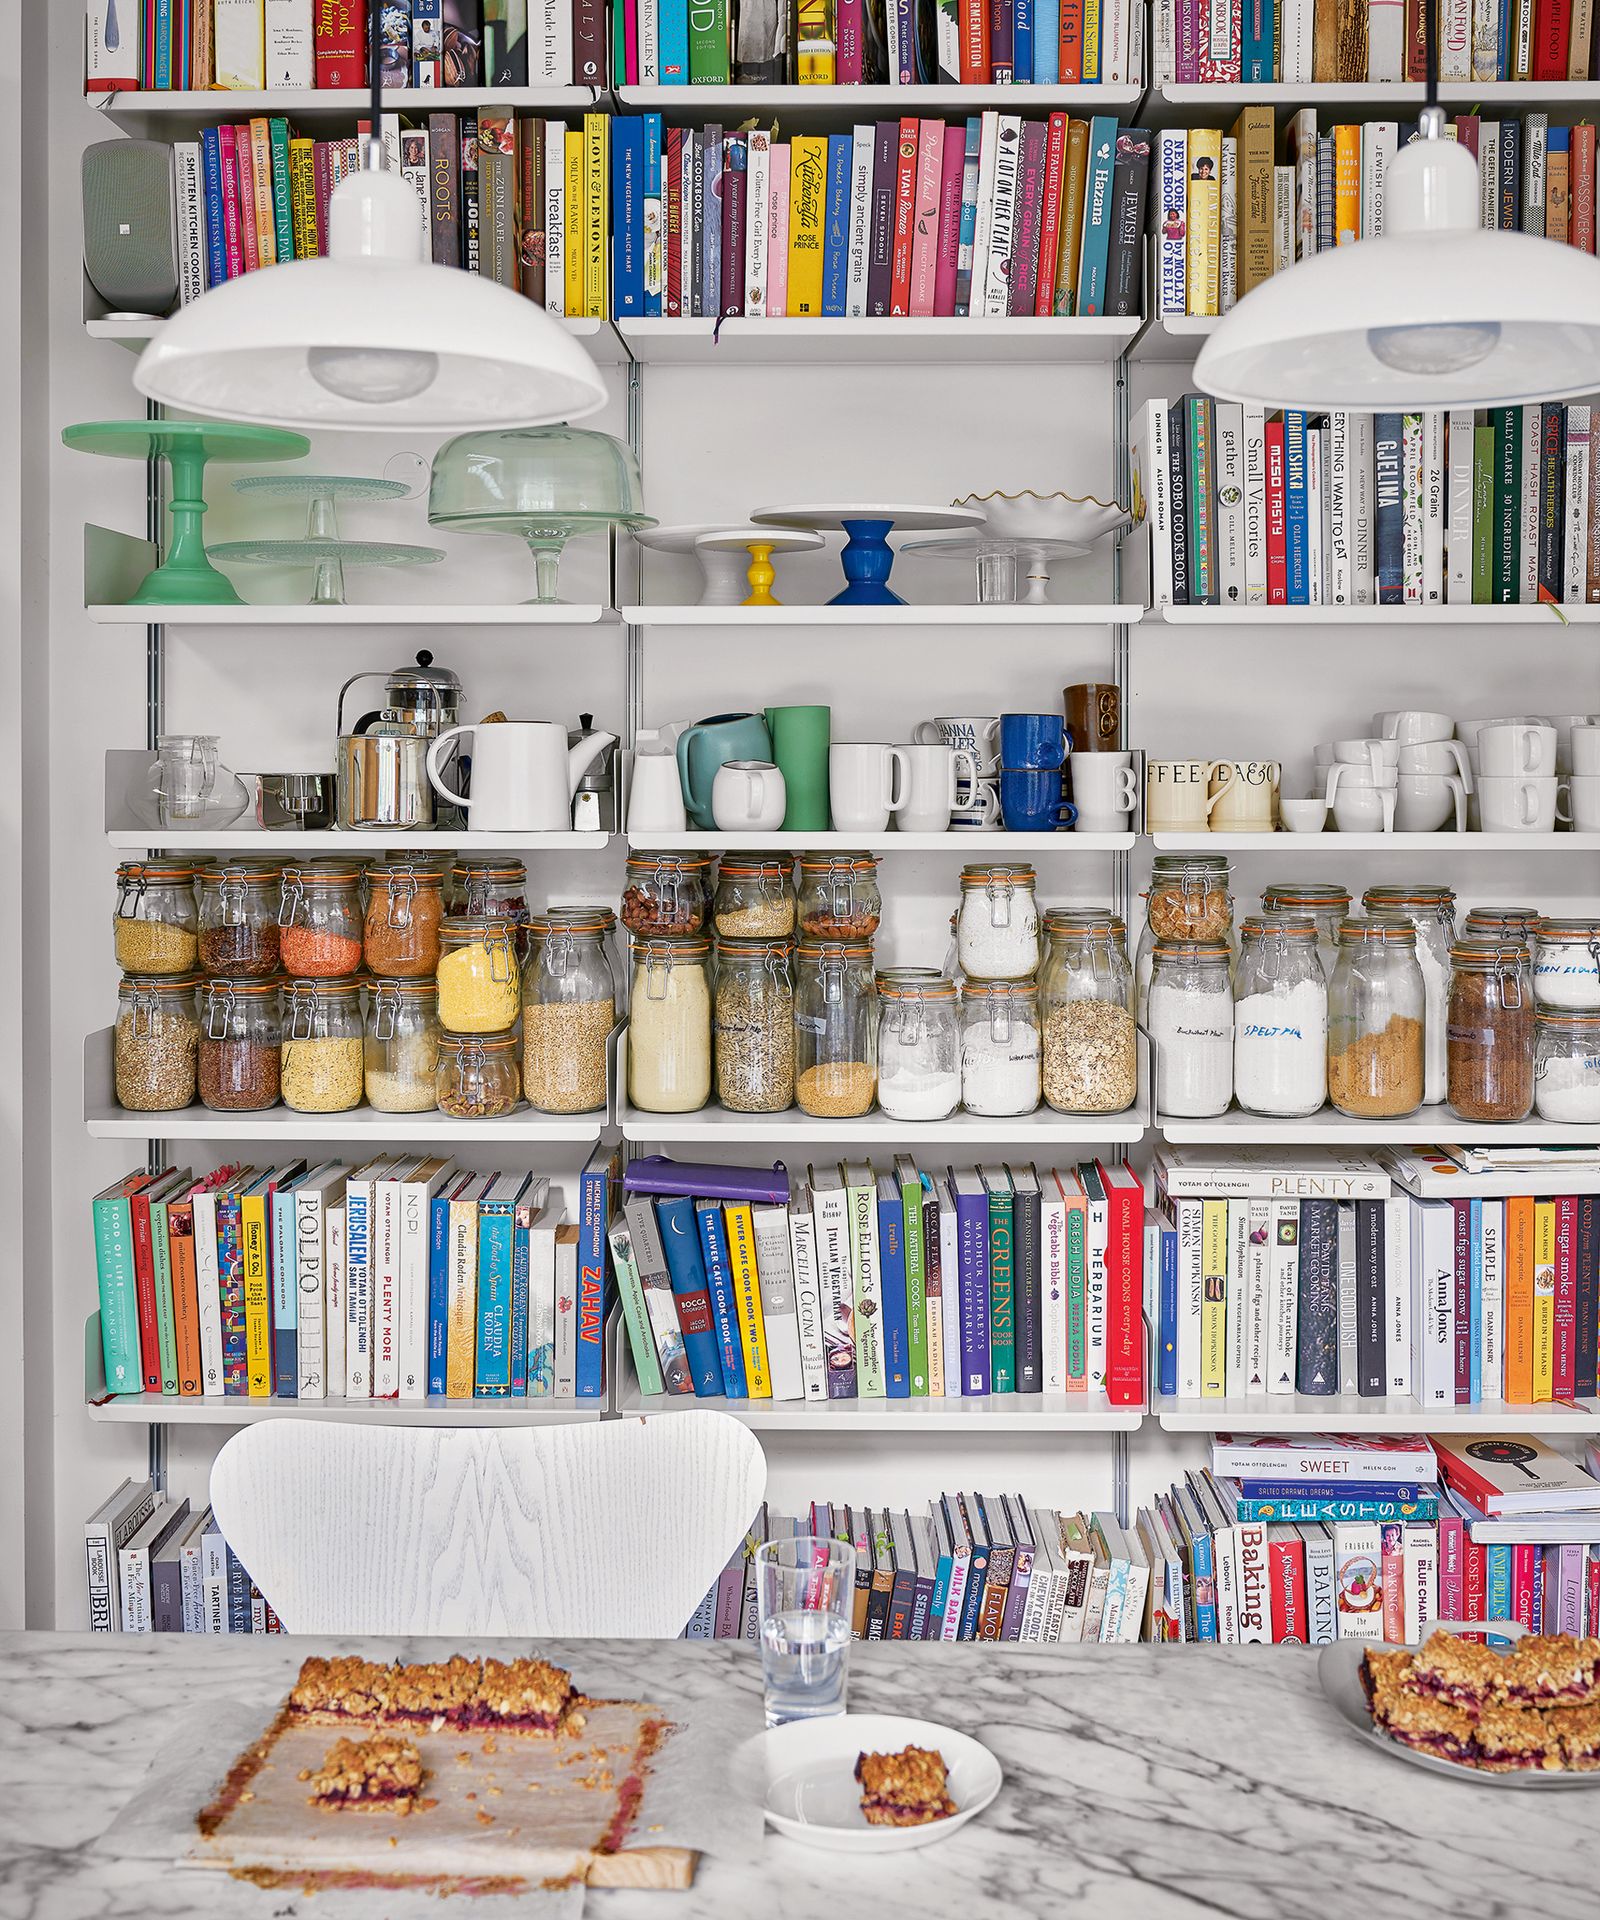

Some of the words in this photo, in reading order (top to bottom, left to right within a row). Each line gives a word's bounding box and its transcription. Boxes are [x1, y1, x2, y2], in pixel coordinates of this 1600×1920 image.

[544, 0, 556, 30] Made
[1063, 3, 1078, 43] fish
[545, 35, 555, 47] In
[1183, 16, 1193, 60] COOKBOOK
[1549, 28, 1559, 60] FOOD
[542, 52, 556, 77] Italy
[592, 135, 600, 178] LOVE
[1052, 131, 1061, 151] THE
[1175, 140, 1184, 173] NEW
[1504, 129, 1513, 185] MODERN
[186, 158, 196, 201] SMITTEN
[208, 136, 217, 190] BAREFOOT
[225, 158, 234, 198] barefoot
[1049, 153, 1059, 190] FAMILY
[1163, 139, 1174, 213] COOKBOOK
[435, 159, 451, 221] ROOTS
[591, 181, 602, 193] &
[754, 171, 763, 219] Gluten-Free
[795, 146, 823, 228] Kitchenella
[857, 165, 868, 202] simply
[901, 169, 911, 197] IVAN
[1091, 168, 1109, 226] Hazana
[1175, 177, 1184, 213] YORK
[1259, 168, 1270, 224] Mediterranean
[211, 194, 219, 247] CONTESSA
[227, 201, 237, 243] contessa
[549, 188, 562, 258] breakfast
[898, 200, 912, 235] Ramen
[1046, 193, 1056, 232] DINNER
[1124, 190, 1139, 245] JEWISH
[1577, 174, 1589, 235] PASSOVER
[188, 205, 198, 249] KITCHEN
[591, 196, 600, 264] LEMONS
[753, 221, 762, 237] Girl
[855, 205, 866, 245] ancient
[213, 251, 221, 285] PARTIE
[231, 246, 238, 255] at
[752, 239, 761, 260] Every
[852, 249, 864, 283] grains
[1173, 242, 1184, 257] by
[752, 262, 761, 278] Day
[1163, 241, 1173, 306] O'NEILL
[1175, 259, 1184, 306] MOLLY
[1505, 411, 1513, 440] SALLY
[1531, 414, 1539, 454] TOAST
[1156, 446, 1163, 454] IN
[1223, 430, 1238, 477] gather
[1248, 438, 1263, 483] Small
[1271, 445, 1281, 487] MISO
[1288, 413, 1303, 489] MAMUSHKA
[1504, 443, 1512, 484] CLARKE
[1376, 440, 1399, 508] GJELINA
[1430, 469, 1439, 482] 26
[1530, 463, 1538, 497] HASH
[1271, 491, 1283, 535] TASTY
[1430, 485, 1439, 518] Grains
[1504, 494, 1512, 505] 30
[1248, 489, 1263, 558] Victories
[1293, 524, 1301, 545] OLIA
[1529, 506, 1537, 548] ROAST
[1357, 518, 1367, 571] DINNER
[1503, 508, 1512, 582] INGREDIENTS
[1294, 547, 1302, 589] HERCULES
[1528, 556, 1536, 591] MASH
[1147, 765, 1201, 782] FFEE
[593, 1180, 601, 1212] MICHAEL
[1271, 1178, 1356, 1195] PLENTY
[407, 1194, 418, 1235] NOPI
[706, 1214, 714, 1232] THE
[858, 1192, 871, 1232] ROSE
[1182, 1209, 1190, 1247] COOKS
[1191, 1209, 1200, 1246] SIMON
[1561, 1200, 1573, 1220] salt
[250, 1223, 260, 1251] Honey
[299, 1198, 319, 1293] POLPO
[348, 1195, 367, 1265] JERUSALEM
[708, 1235, 718, 1262] RIVER
[826, 1227, 839, 1263] ITALIAN
[888, 1223, 897, 1255] trullo
[964, 1219, 972, 1265] WORLD
[975, 1222, 983, 1276] MADHUR
[1048, 1211, 1059, 1259] Vegetable
[1071, 1215, 1080, 1254] FRESH
[1557, 1224, 1571, 1254] sugar
[252, 1262, 261, 1275] Co.
[860, 1235, 874, 1293] ELLIOT'S
[1051, 1261, 1059, 1286] Bible
[1485, 1228, 1495, 1282] SIMPLE
[349, 1267, 357, 1289] SAMI
[358, 1267, 366, 1296] YOTAM
[712, 1264, 722, 1287] CAFE
[828, 1267, 842, 1321] VEGETARIAN
[991, 1228, 1011, 1328] GREENS
[1071, 1259, 1080, 1298] INDIA
[1191, 1249, 1200, 1316] HOPKINSON
[1561, 1257, 1572, 1295] smoke
[349, 1291, 357, 1323] TAMIMI
[383, 1276, 392, 1322] PLENTY
[580, 1265, 601, 1345] ZAHAV
[716, 1290, 726, 1315] COOK
[965, 1273, 973, 1353] VEGETARIAN
[1092, 1248, 1102, 1347] HERBARIUM
[358, 1299, 366, 1353] OTTOLENGHI
[720, 1318, 731, 1344] BOOK
[975, 1284, 984, 1350] JAFFREY'S
[382, 1327, 391, 1361] MORE
[1300, 1460, 1350, 1473] SWEET
[1258, 1488, 1280, 1496] SALTED
[1281, 1488, 1308, 1496] CARAMEL
[1309, 1488, 1334, 1496] DREAMS
[1281, 1503, 1395, 1517] FEASTS
[96, 1550, 104, 1583] LAROUSSE
[951, 1565, 964, 1595] MILK
[1222, 1556, 1231, 1592] Lebovitz
[1241, 1526, 1264, 1630] Baking
[1418, 1559, 1426, 1586] BLUE
[211, 1585, 221, 1624] TARTINE
[724, 1586, 733, 1621] Wholefood
[933, 1580, 944, 1609] ovenly
[946, 1600, 957, 1624] BAR
[966, 1573, 981, 1621] momofuku
[1418, 1589, 1427, 1623] CHAIR
[1564, 1579, 1579, 1632] Layered
[1225, 1606, 1233, 1632] Ready
